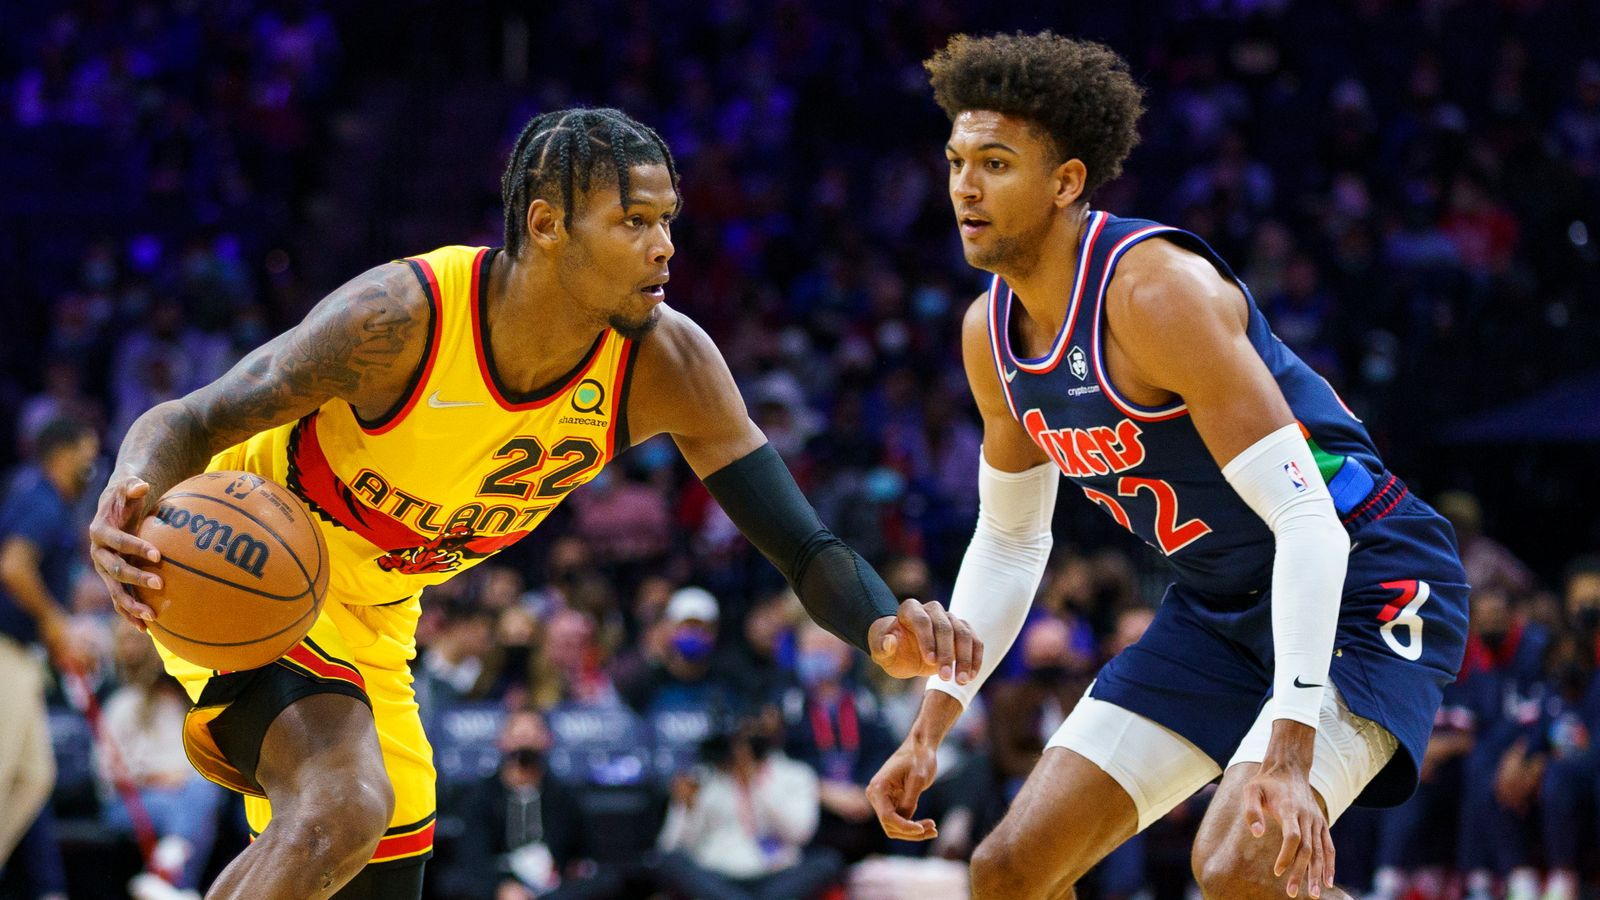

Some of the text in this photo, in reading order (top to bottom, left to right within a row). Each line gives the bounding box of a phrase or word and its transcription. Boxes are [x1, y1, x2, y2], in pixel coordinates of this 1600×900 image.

[558, 416, 608, 428] sharecare
[1067, 384, 1100, 397] crypto.com
[349, 467, 557, 535] ATLANT
[476, 434, 604, 501] 22
[157, 505, 270, 580] Wilson
[1376, 579, 1430, 662] 76
